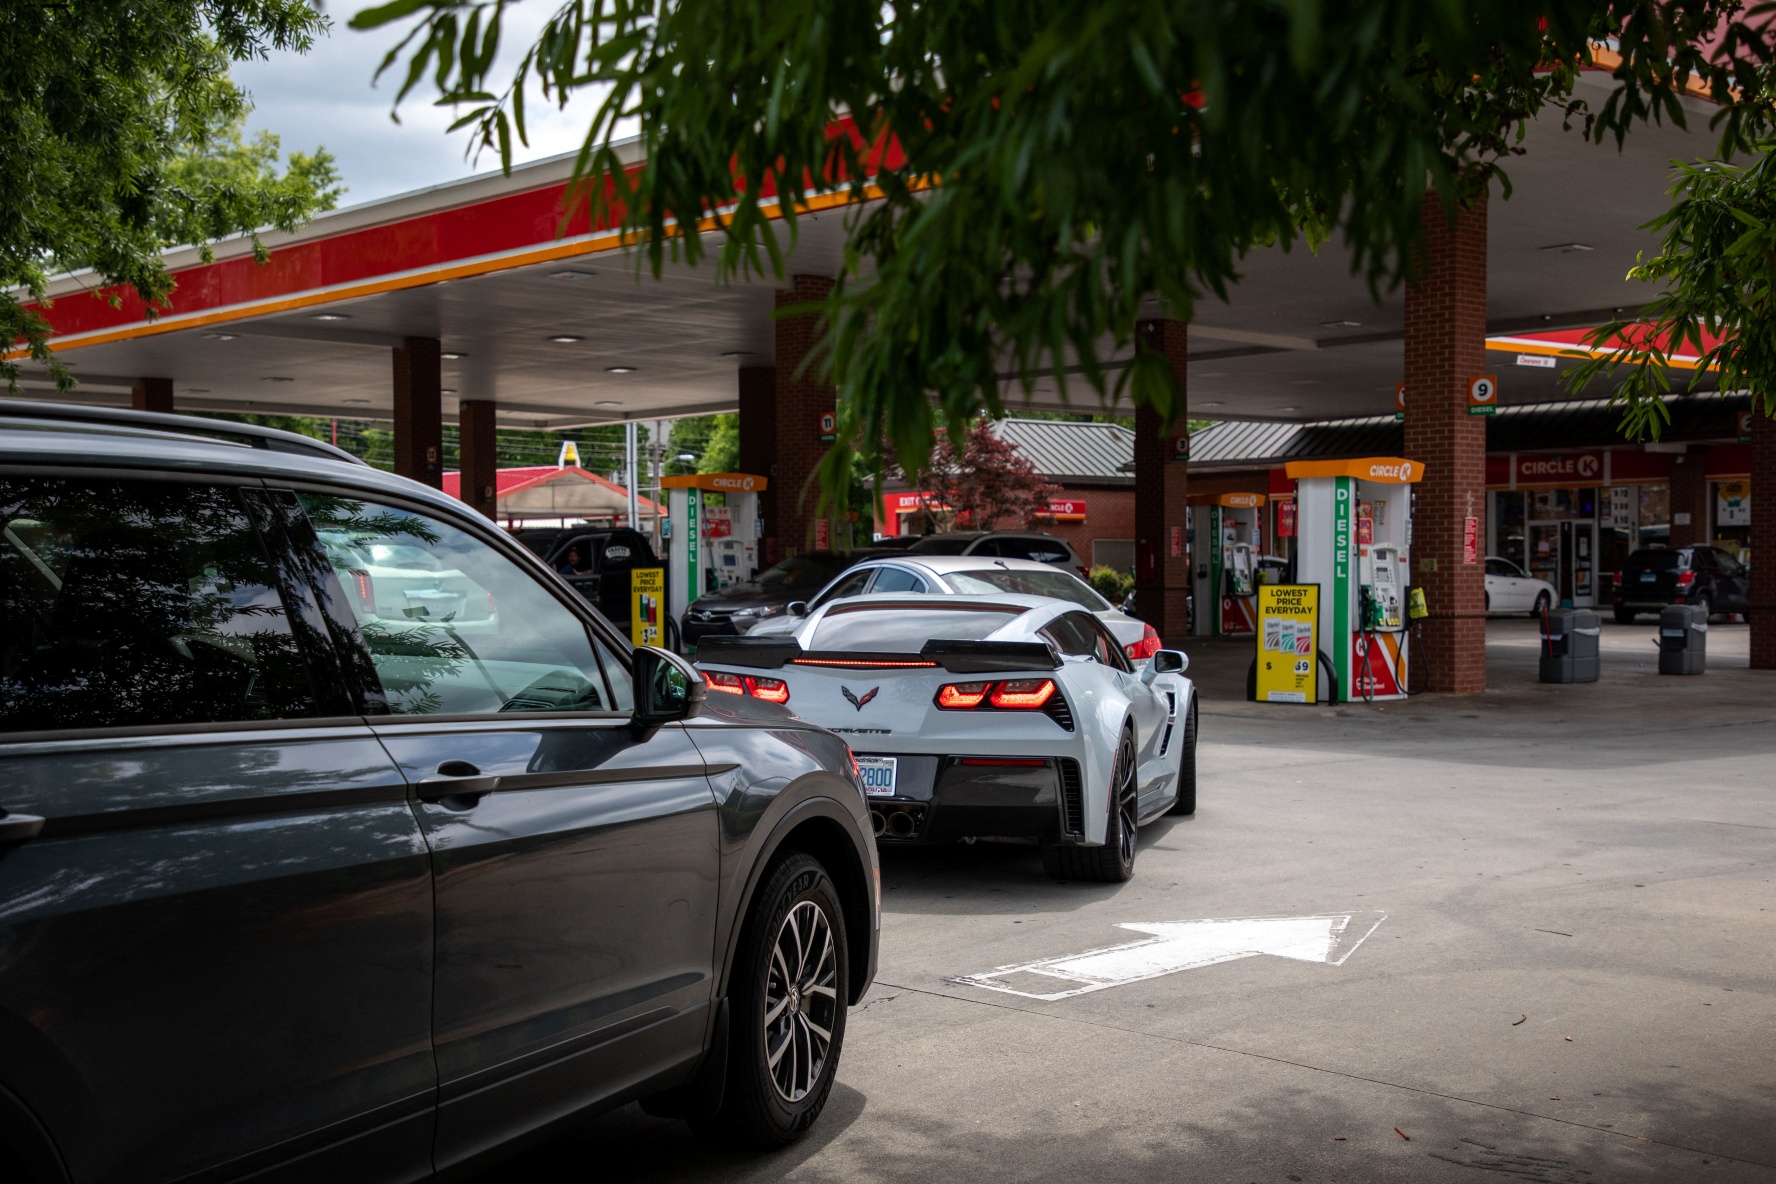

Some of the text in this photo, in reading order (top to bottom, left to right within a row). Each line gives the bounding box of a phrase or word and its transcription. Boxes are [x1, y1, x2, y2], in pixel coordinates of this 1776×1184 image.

[1478, 383, 1488, 396] 9
[824, 418, 831, 428] 11
[1180, 440, 1186, 449] 3
[1522, 455, 1598, 477] CIRCLE K
[1370, 463, 1411, 481] CIRCLE K
[713, 477, 754, 491] CIRCLE K
[900, 496, 915, 506] EXIT
[1230, 496, 1249, 504] CIRCLE
[688, 496, 696, 562] DIESEL
[1336, 488, 1348, 578] DIESEL
[1211, 511, 1219, 564] DIESEL
[1271, 589, 1308, 597] LOWEST
[1276, 598, 1302, 606] PRICE
[1265, 606, 1313, 615] EVERYDAY
[1266, 661, 1272, 670] $
